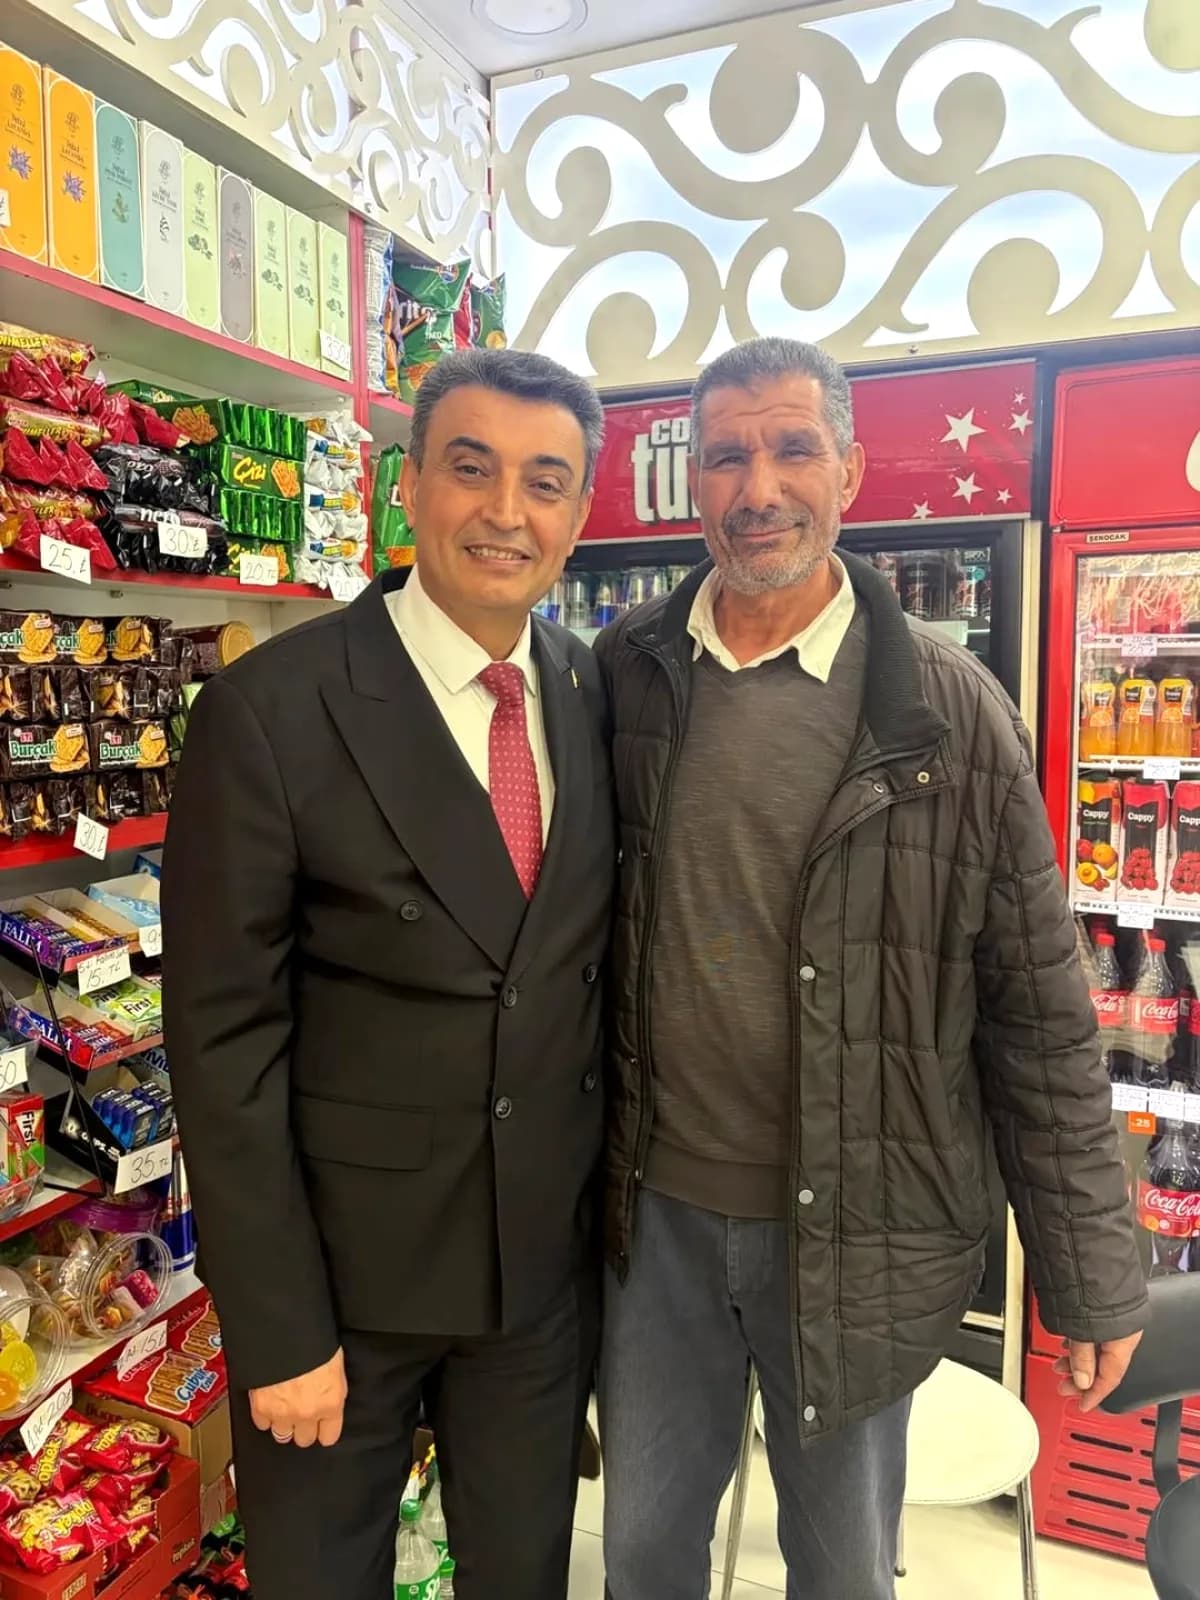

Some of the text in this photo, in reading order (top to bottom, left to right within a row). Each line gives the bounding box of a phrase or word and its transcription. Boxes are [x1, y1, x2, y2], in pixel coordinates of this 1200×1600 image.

[651, 417, 691, 446] CO
[631, 433, 700, 521] tu
[9, 739, 57, 759] Burçak
[100, 741, 142, 760] Burçak
[1083, 809, 1109, 819] Cappy
[1127, 811, 1155, 822] Cappy
[1179, 815, 1200, 826] Capp
[123, 997, 152, 1015] First
[22, 1111, 36, 1144] First
